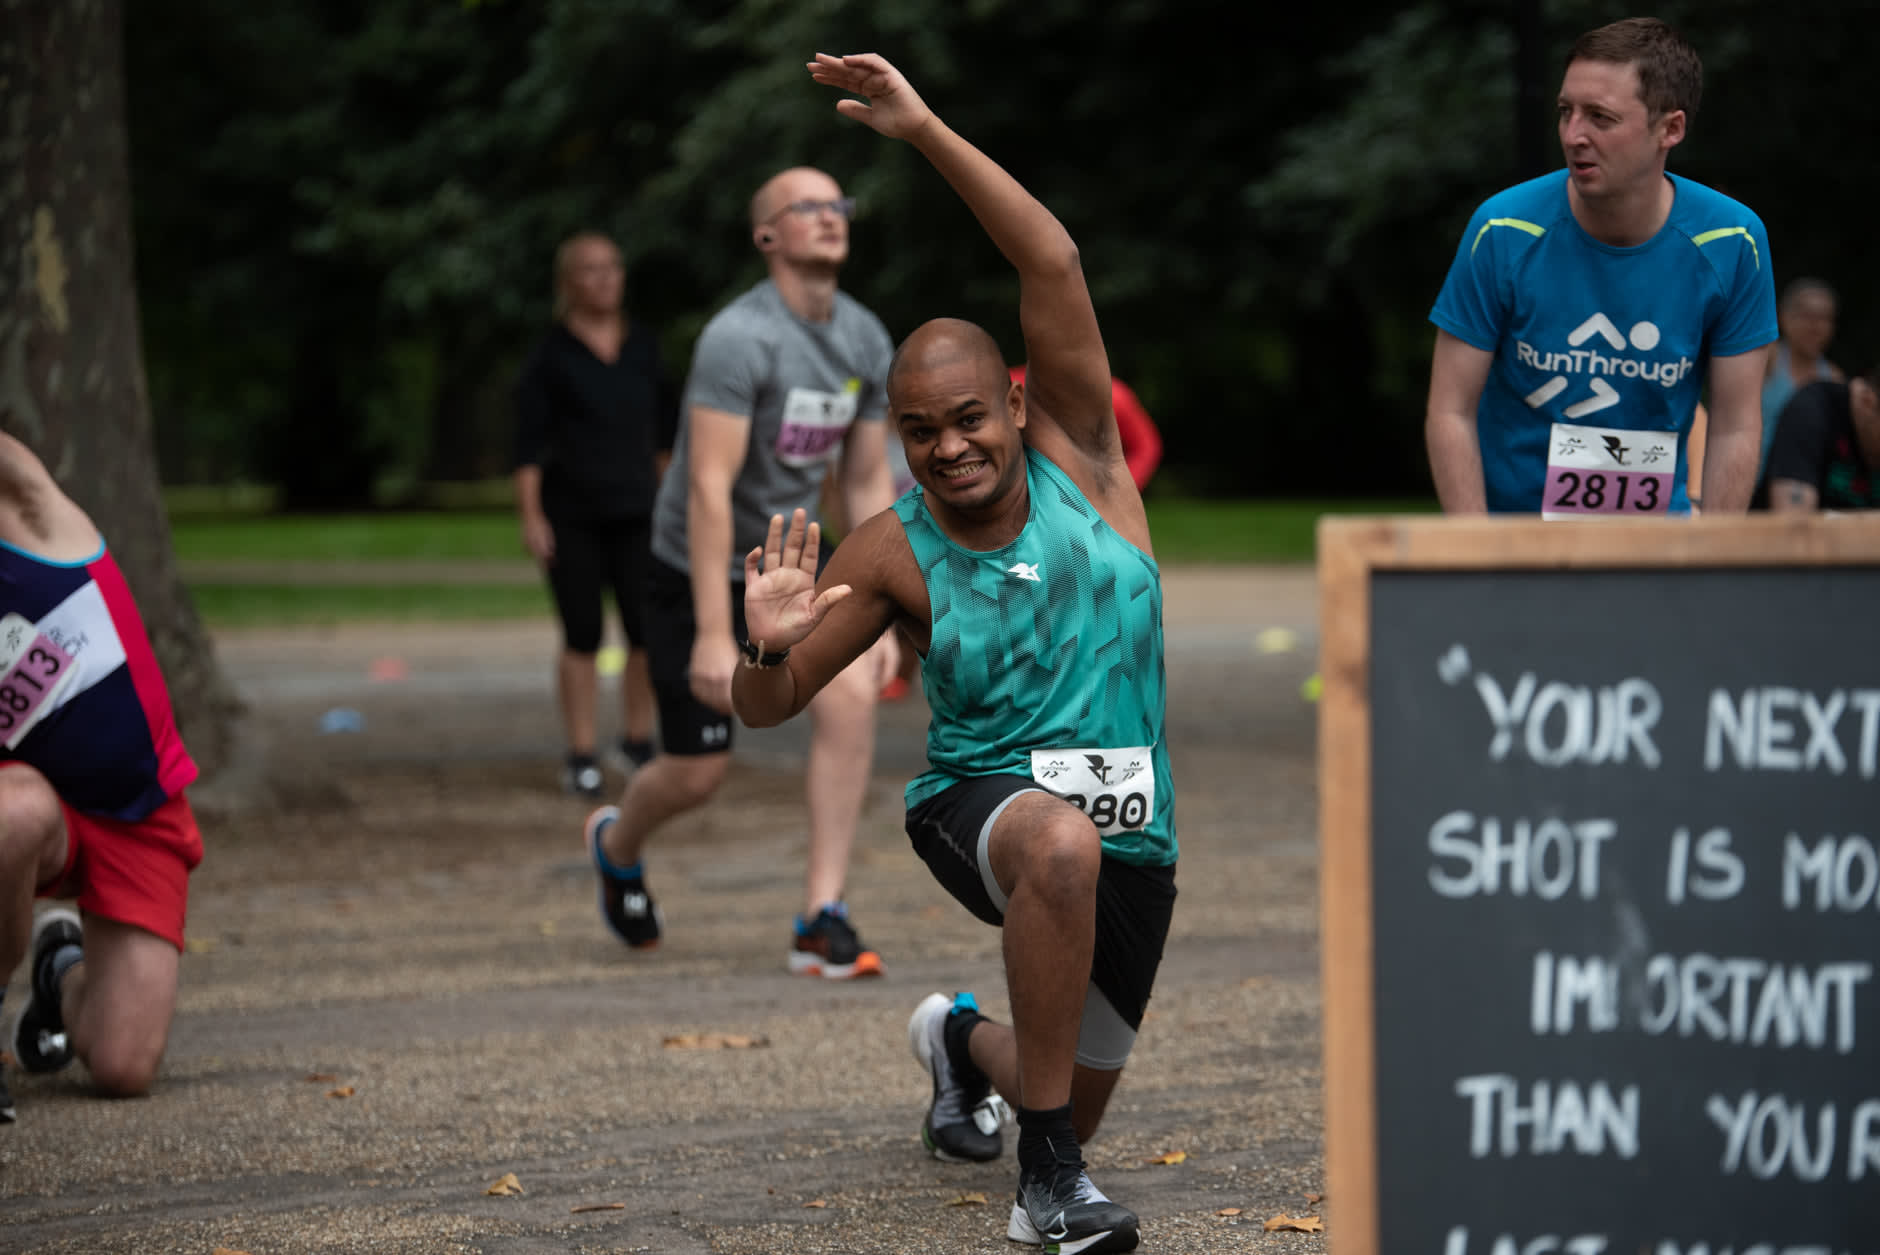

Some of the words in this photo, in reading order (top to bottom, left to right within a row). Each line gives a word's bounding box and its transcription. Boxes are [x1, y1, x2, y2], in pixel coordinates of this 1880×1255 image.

[1517, 340, 1694, 388] RunThrough
[1553, 471, 1661, 511] 2813
[1704, 687, 1880, 777] NEXT
[1428, 810, 1617, 900] SHOT
[1667, 828, 1744, 904] IS
[1783, 834, 1880, 910] MO
[1531, 951, 1871, 1053] IMORTANT
[1456, 1073, 1640, 1158] THAN
